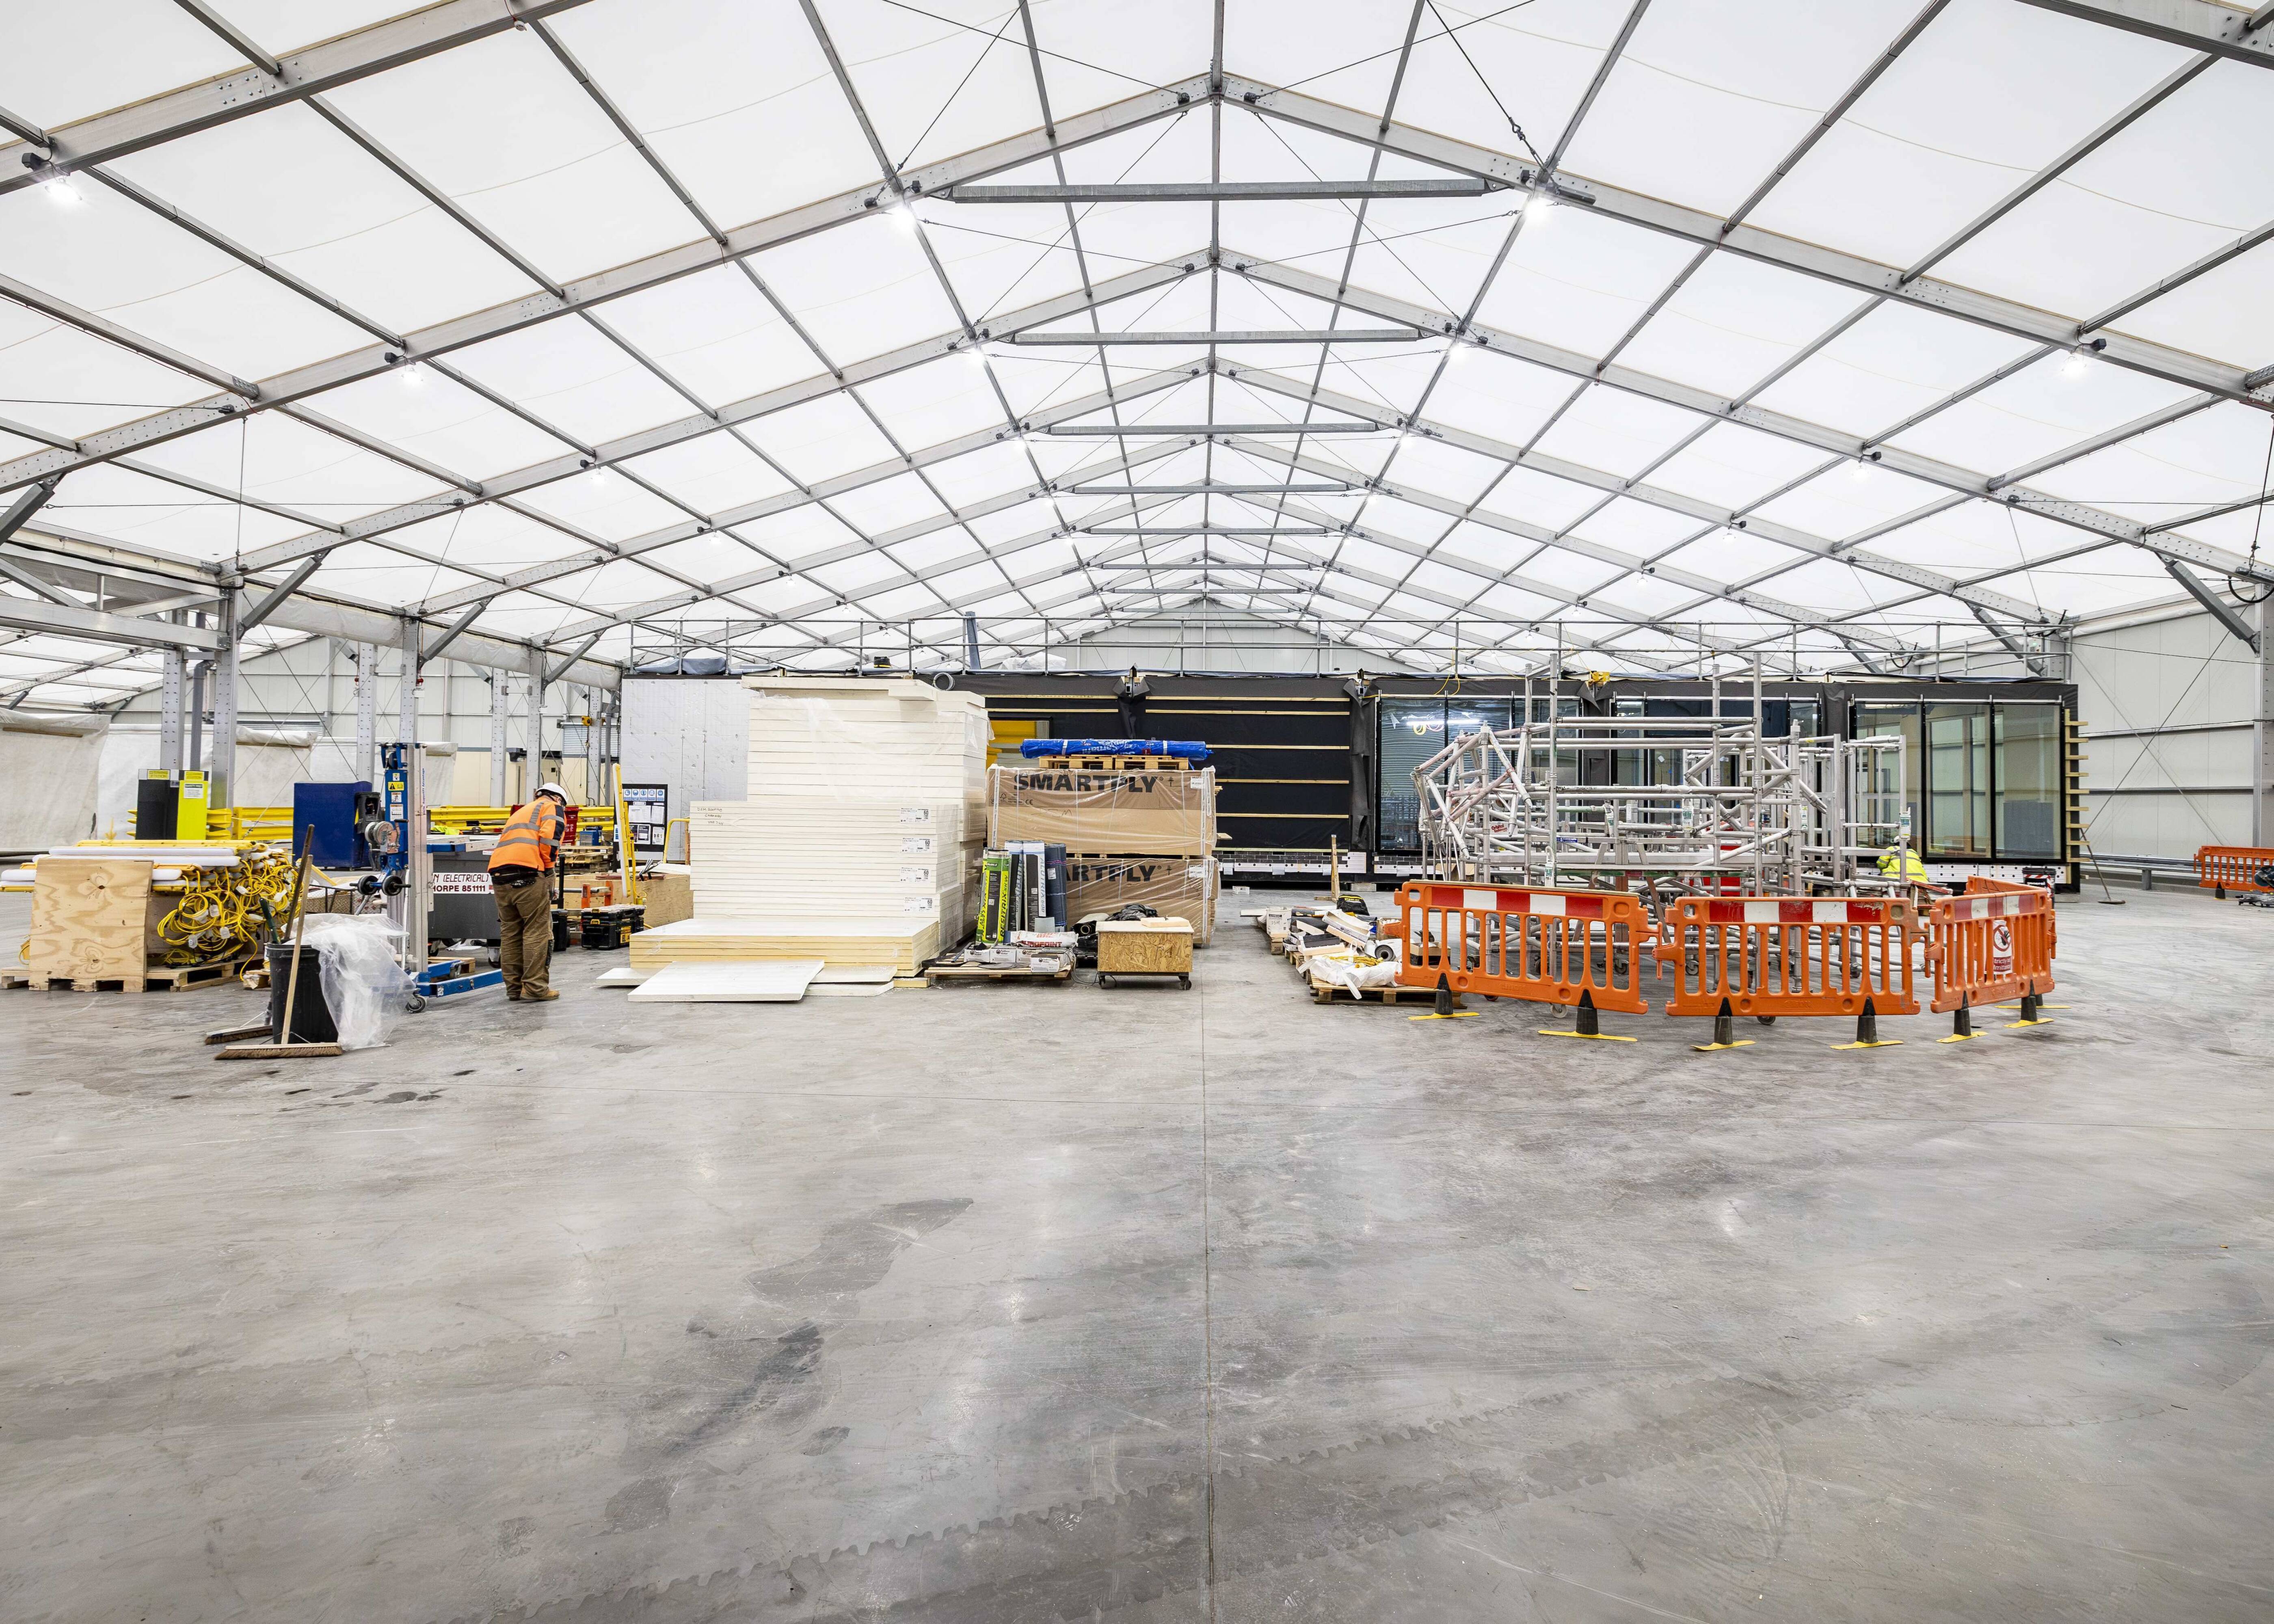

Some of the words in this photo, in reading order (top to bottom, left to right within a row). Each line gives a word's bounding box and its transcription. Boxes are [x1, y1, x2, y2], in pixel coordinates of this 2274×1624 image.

[1014, 773, 1157, 793] SMARTPLY
[443, 874, 489, 882] (ELECTRICAL)
[1066, 865, 1156, 882] RTPLY
